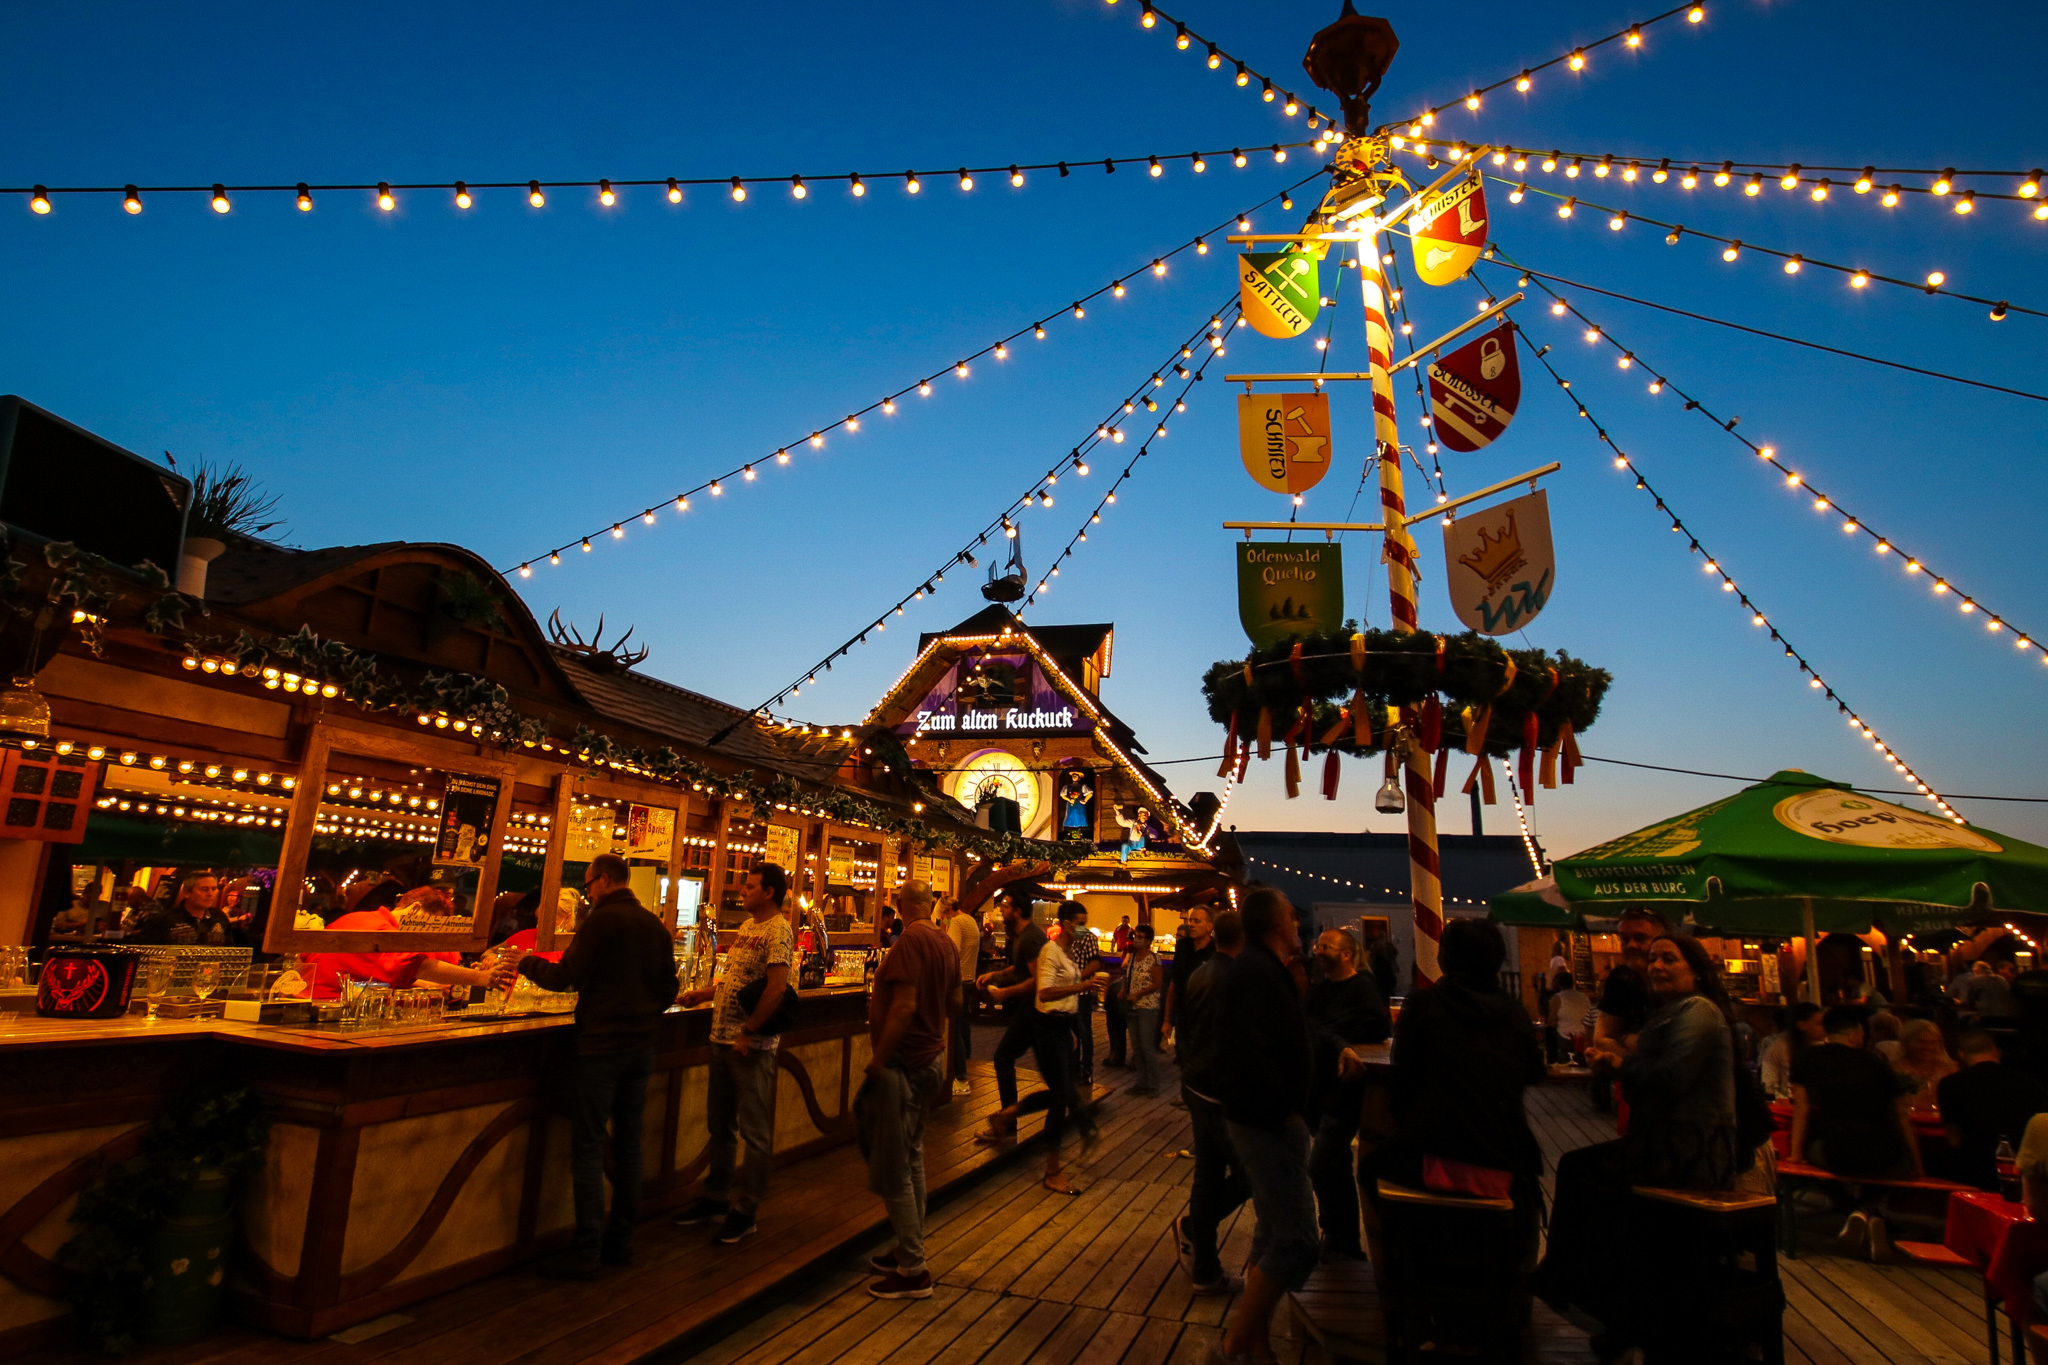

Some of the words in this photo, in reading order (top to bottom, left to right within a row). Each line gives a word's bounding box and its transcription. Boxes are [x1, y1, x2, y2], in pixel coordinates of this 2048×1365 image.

[1420, 176, 1479, 223] CHUSTER
[1244, 270, 1302, 331] SATTLER
[1433, 360, 1500, 414] SCHLOSSER
[1265, 408, 1286, 479] SCHMIED
[1246, 548, 1321, 563] Odenwald
[1262, 566, 1317, 586] Quelle
[916, 710, 956, 731] Zum
[961, 709, 998, 730] alten
[1005, 706, 1073, 729] Kuckuck
[1575, 864, 1696, 879] BIERSPEZIALITÄTEN
[1594, 883, 1620, 895] AUS
[1624, 883, 1648, 894] DER
[1651, 883, 1687, 894] BURG
[401, 918, 426, 929] Achtung
